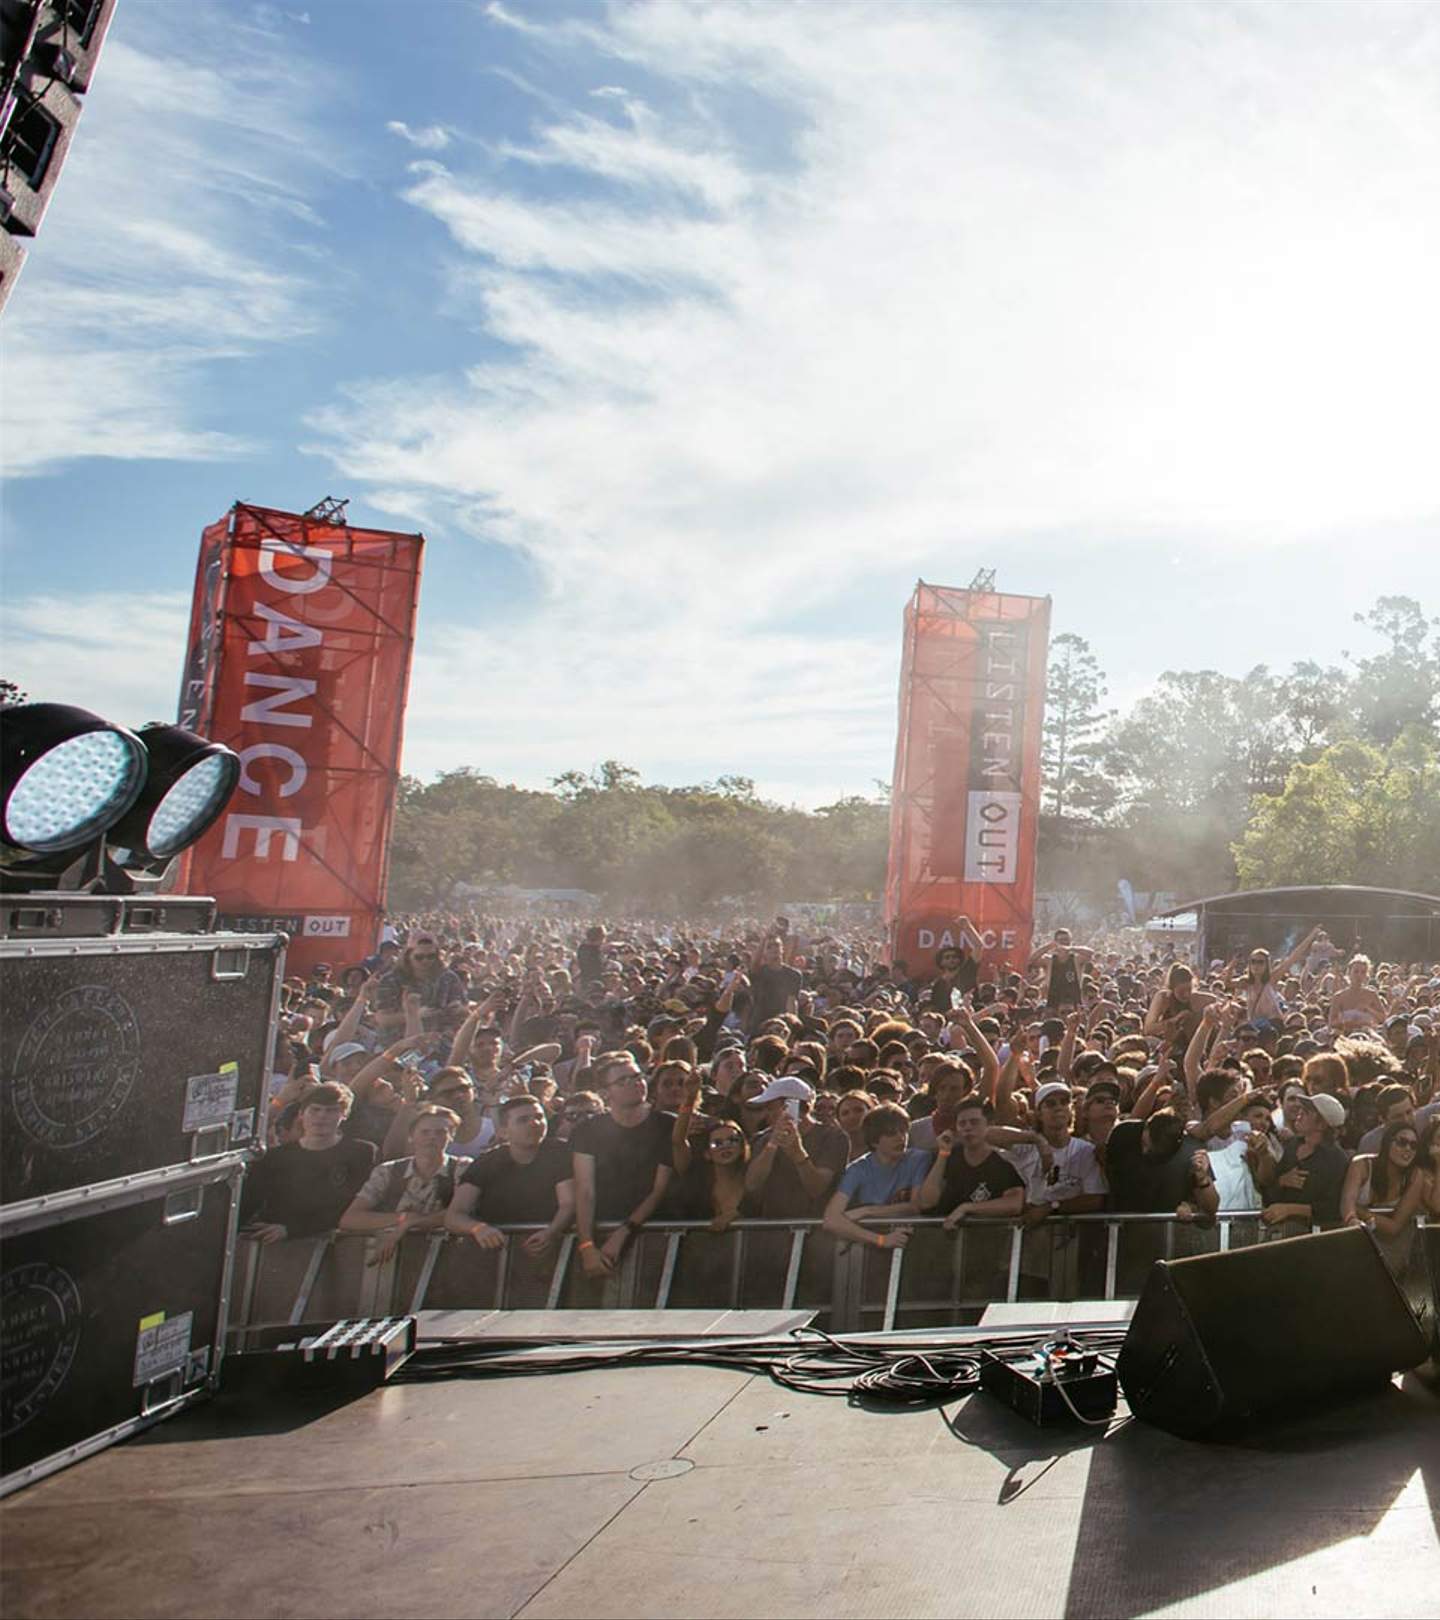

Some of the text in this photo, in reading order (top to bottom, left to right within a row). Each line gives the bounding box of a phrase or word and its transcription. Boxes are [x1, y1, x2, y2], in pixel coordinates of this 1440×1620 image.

[222, 539, 332, 862] DANCE
[977, 631, 1016, 874] LISTEN OUT
[219, 917, 346, 932] LISTEN OUT
[918, 929, 1016, 949] DANCE
